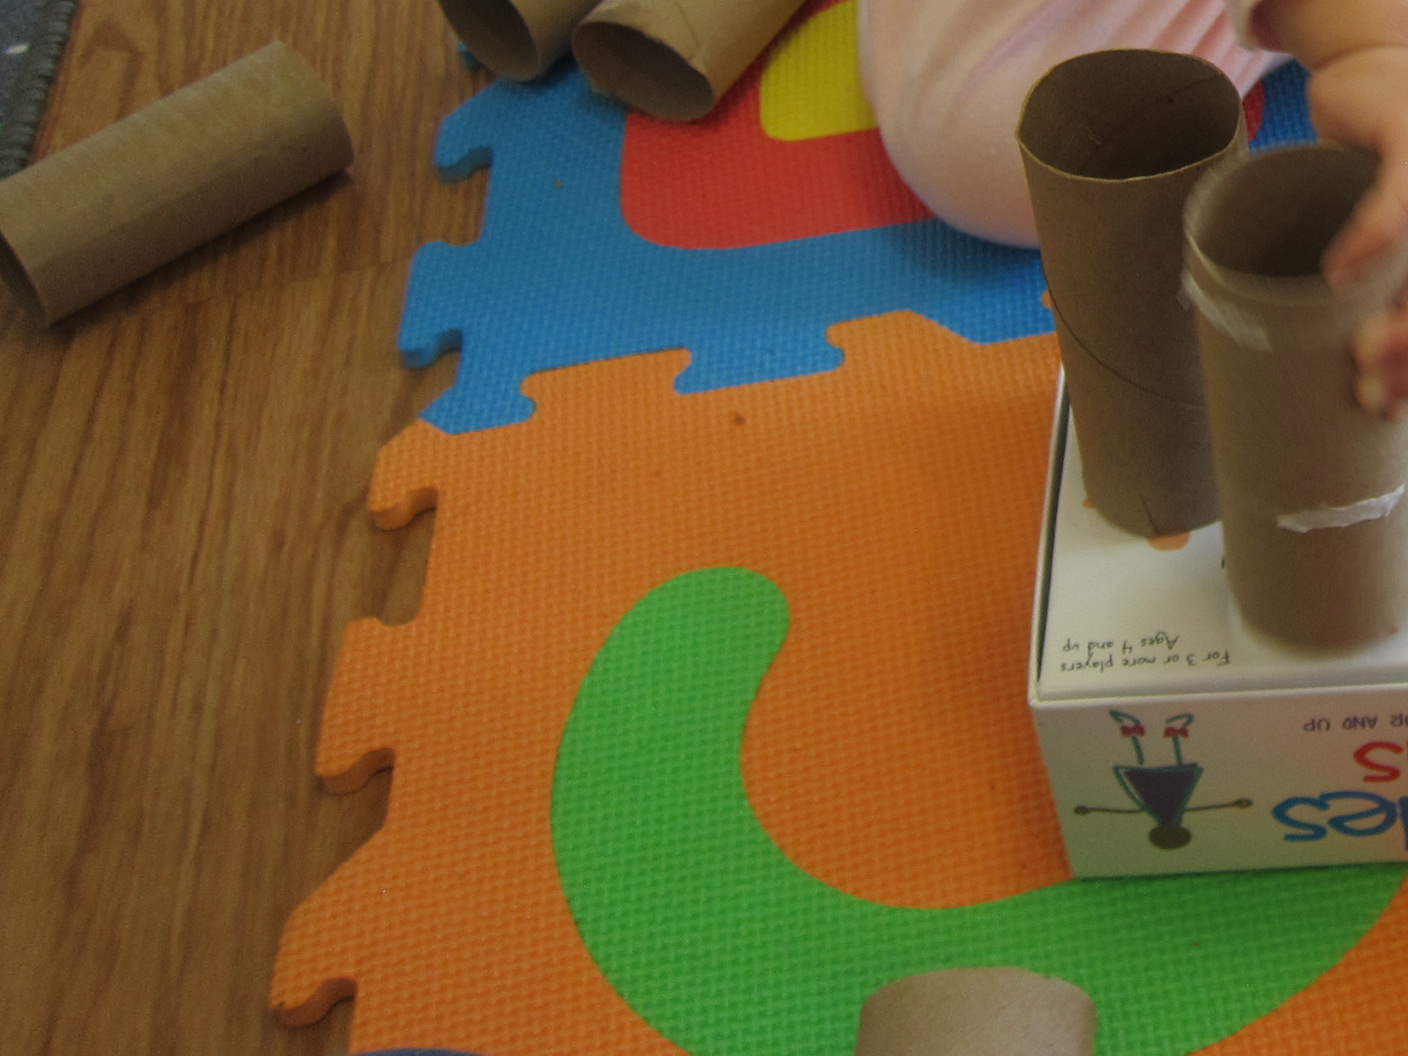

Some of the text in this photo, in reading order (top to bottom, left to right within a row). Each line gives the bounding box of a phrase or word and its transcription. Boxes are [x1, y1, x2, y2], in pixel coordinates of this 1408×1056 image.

[1062, 631, 1179, 655] Ages 4 and up
[1060, 651, 1231, 673] For 3 or more players
[1302, 717, 1330, 732] UP
[1342, 716, 1378, 730] AND
